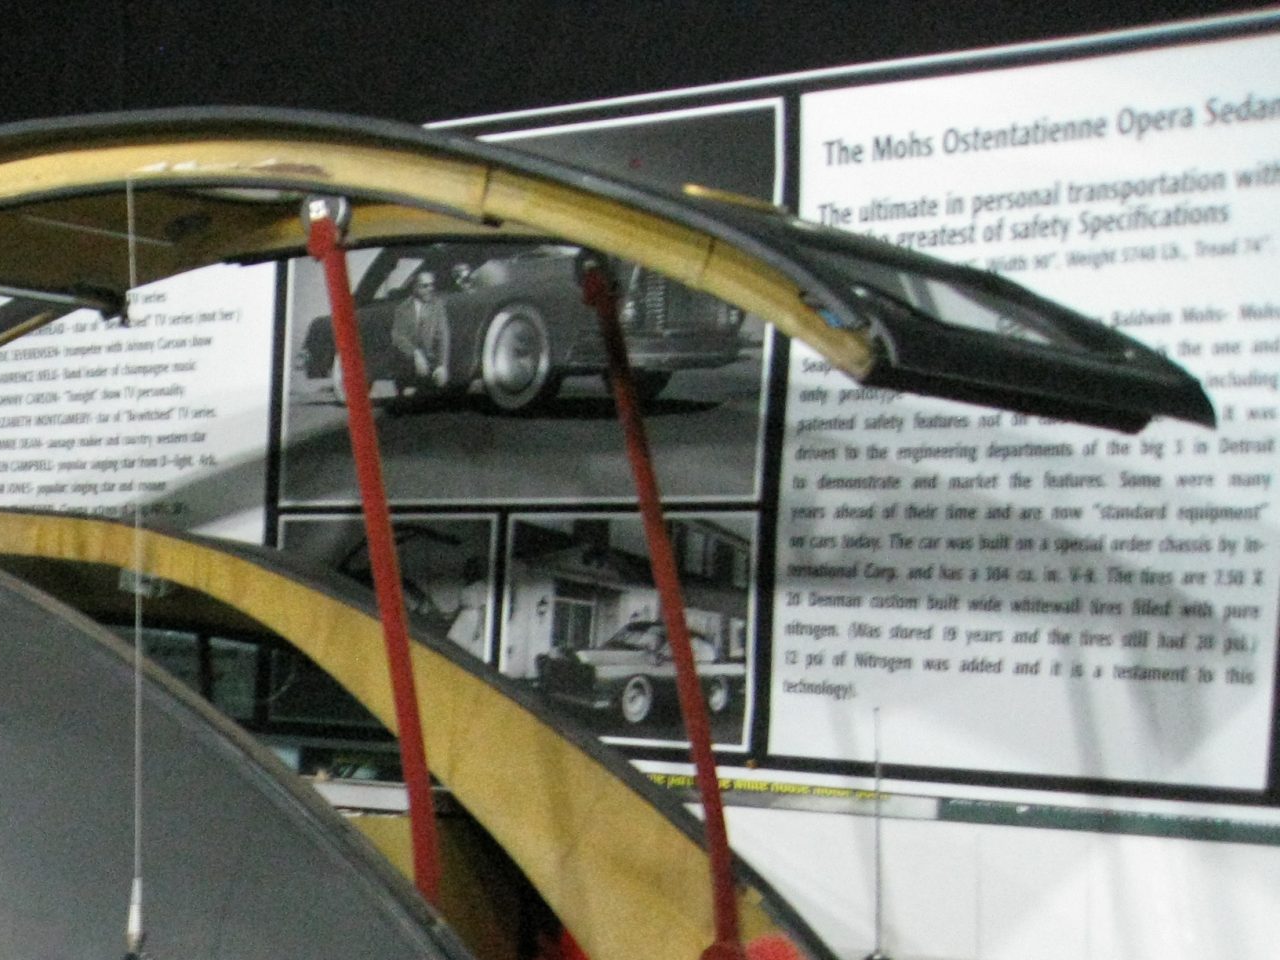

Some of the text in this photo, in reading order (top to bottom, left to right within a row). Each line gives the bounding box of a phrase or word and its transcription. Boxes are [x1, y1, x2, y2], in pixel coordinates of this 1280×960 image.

[823, 138, 864, 166] The
[872, 130, 934, 162] Mohs
[942, 116, 1107, 154] Ostentatienne
[1117, 106, 1195, 141] Opera
[818, 202, 852, 226] The
[858, 196, 939, 223] ultimate
[945, 191, 964, 215] in
[971, 180, 1060, 219] personal
[1068, 168, 1227, 205] transportation
[982, 217, 1004, 243] of
[1010, 213, 1071, 242] safety
[1078, 200, 1230, 240] Specifications
[796, 415, 856, 435] patented
[864, 413, 904, 433] safety
[914, 412, 970, 429] features
[895, 441, 978, 463] engineering
[986, 439, 1074, 462] departments
[817, 472, 901, 490] demonstrate
[912, 472, 939, 490] and
[833, 502, 874, 520] ahead
[889, 532, 914, 549] The
[965, 630, 1004, 647] years
[1012, 627, 1041, 644] and
[854, 652, 913, 673] Nitrogen
[923, 658, 951, 672] was
[959, 656, 1005, 674] added
[1012, 658, 1041, 675] and
[1113, 664, 1189, 683] testament
